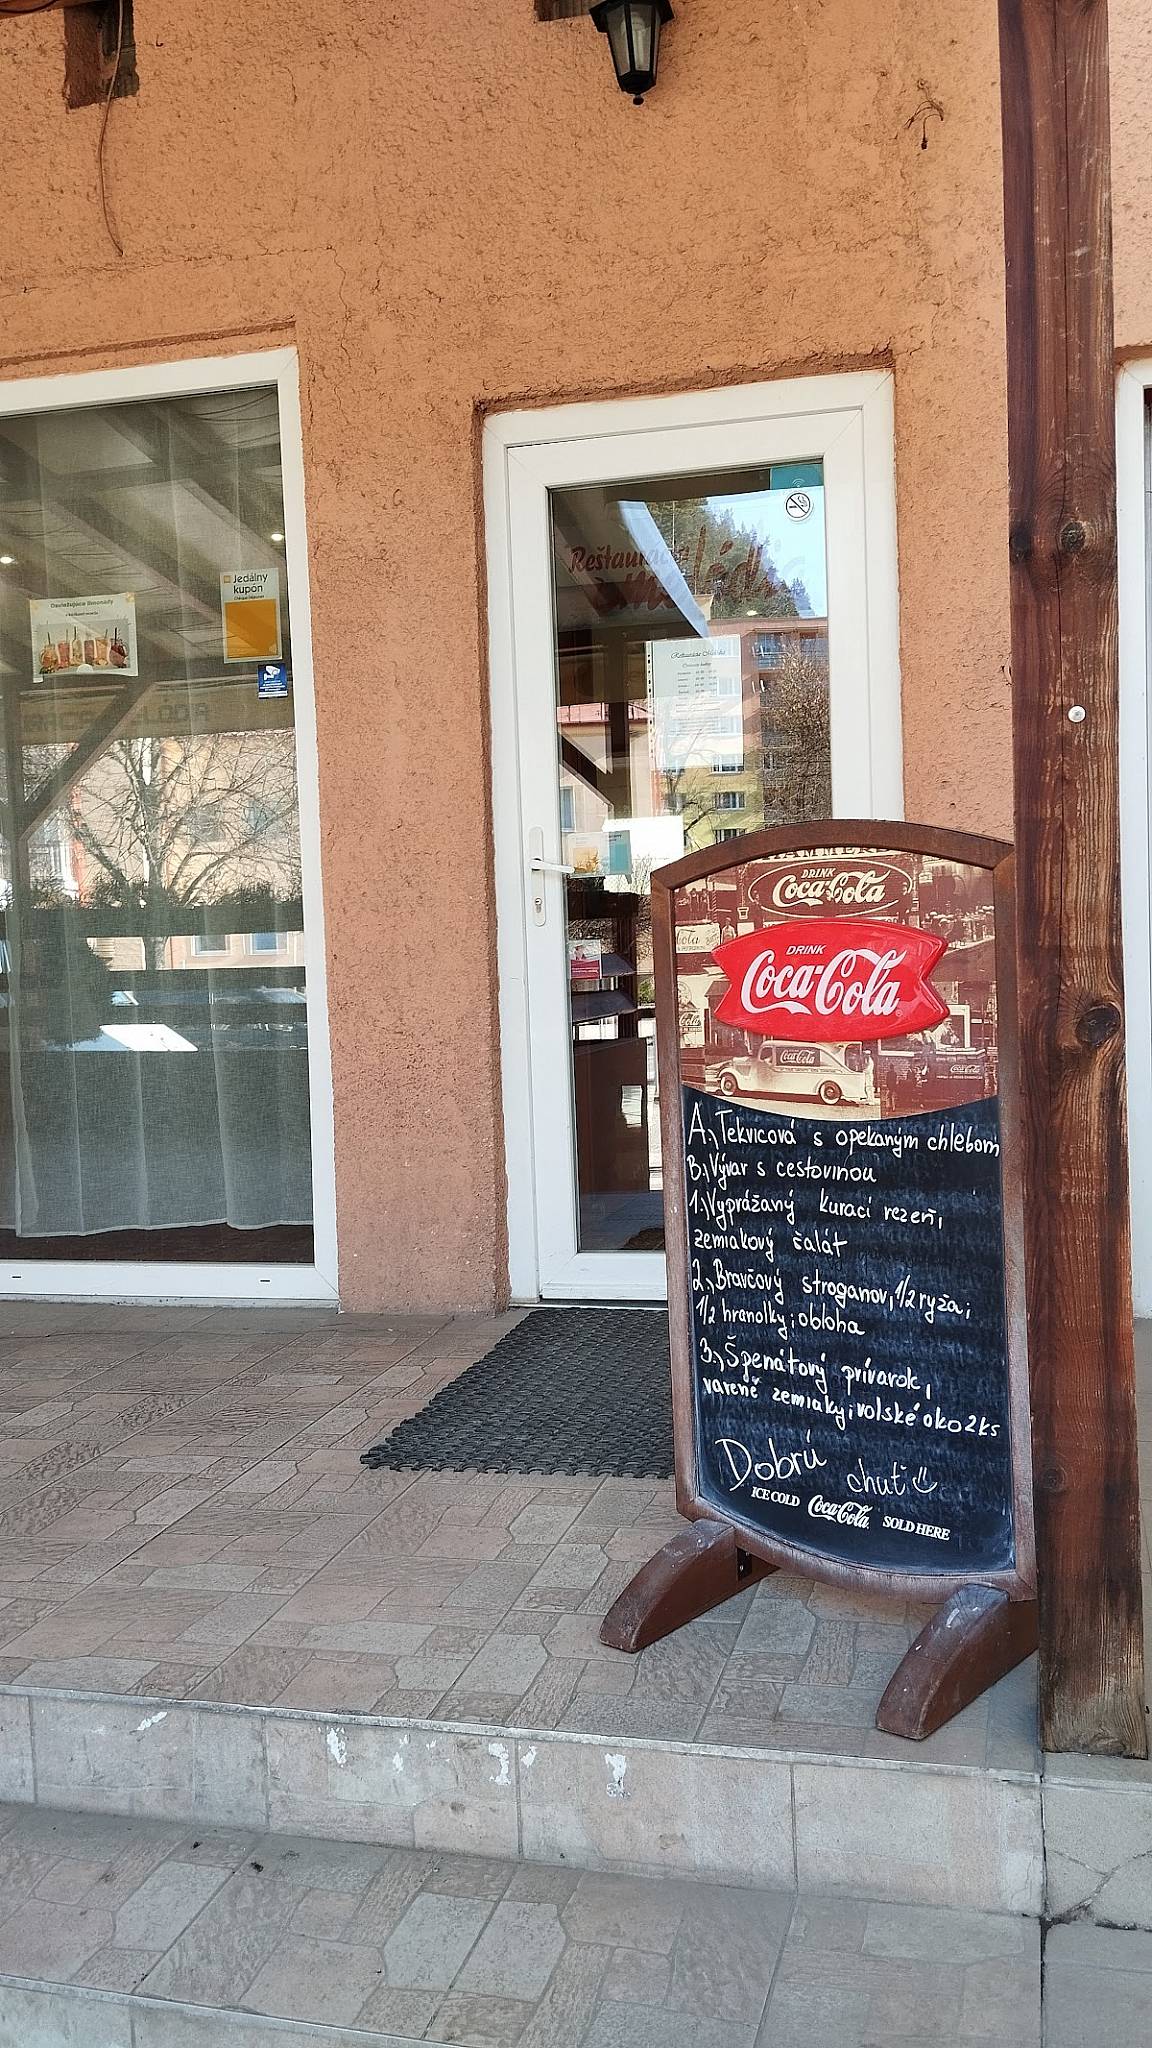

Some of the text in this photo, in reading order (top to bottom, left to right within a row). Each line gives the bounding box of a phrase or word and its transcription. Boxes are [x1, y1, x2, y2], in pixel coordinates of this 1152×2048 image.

[232, 571, 268, 586] Jedálny
[233, 583, 264, 597] kupón
[772, 869, 891, 907] Coca-Cola
[801, 867, 836, 879] DRINK
[785, 944, 826, 956] DRINK
[740, 948, 907, 1017] Coca-Cola
[813, 1130, 824, 1147] s
[835, 1124, 919, 1158] opekaným
[927, 1123, 1000, 1158] chlebom
[757, 1160, 766, 1177] s
[776, 1156, 878, 1183] cestovinou
[693, 1226, 774, 1263] zemiakový
[695, 1294, 716, 1325] 1/2
[798, 1302, 866, 1337] obloha
[724, 1335, 828, 1394] Špenátový
[856, 1401, 921, 1428] volské
[922, 1406, 963, 1433] oko
[714, 1428, 828, 1492] Dobrú
[750, 1485, 951, 1542] ICE COLD Coca-Cola SOLD HERE
